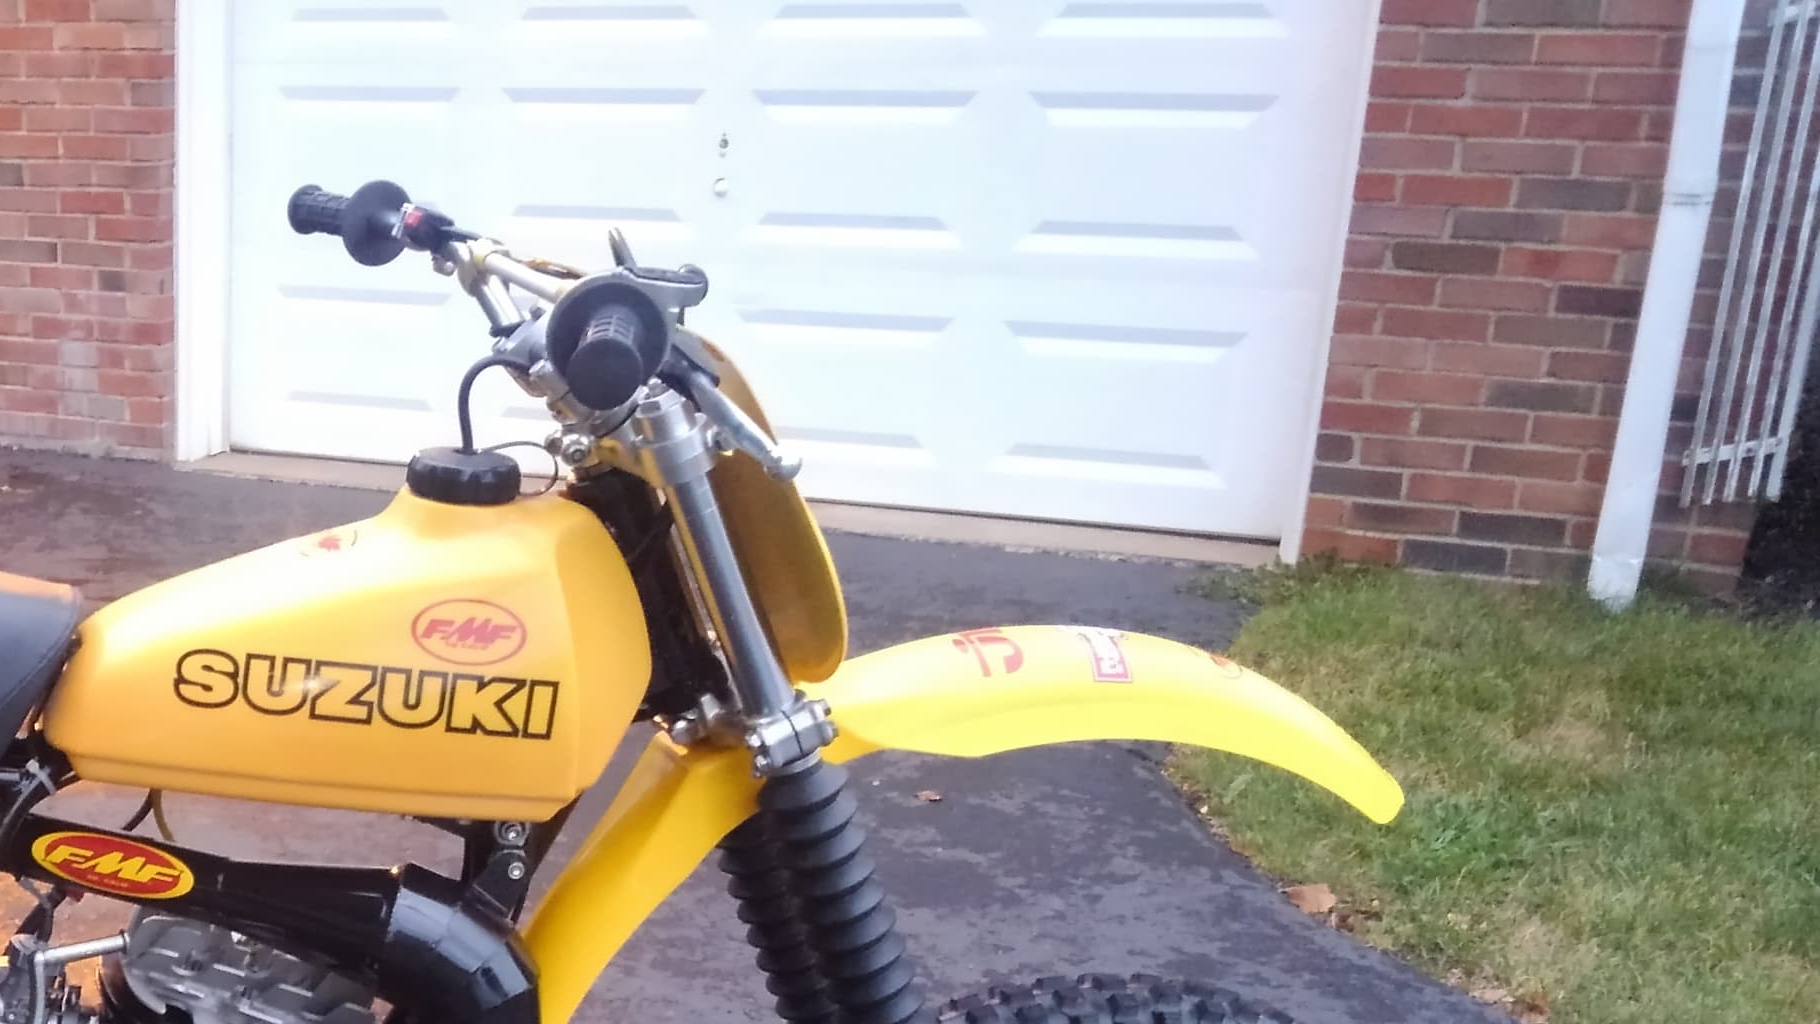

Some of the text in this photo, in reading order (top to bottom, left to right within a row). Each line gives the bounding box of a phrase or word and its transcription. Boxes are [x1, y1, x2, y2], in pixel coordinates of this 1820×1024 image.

[420, 616, 517, 644] FMF
[173, 648, 560, 742] SUZUKI
[44, 845, 181, 883] FMF
